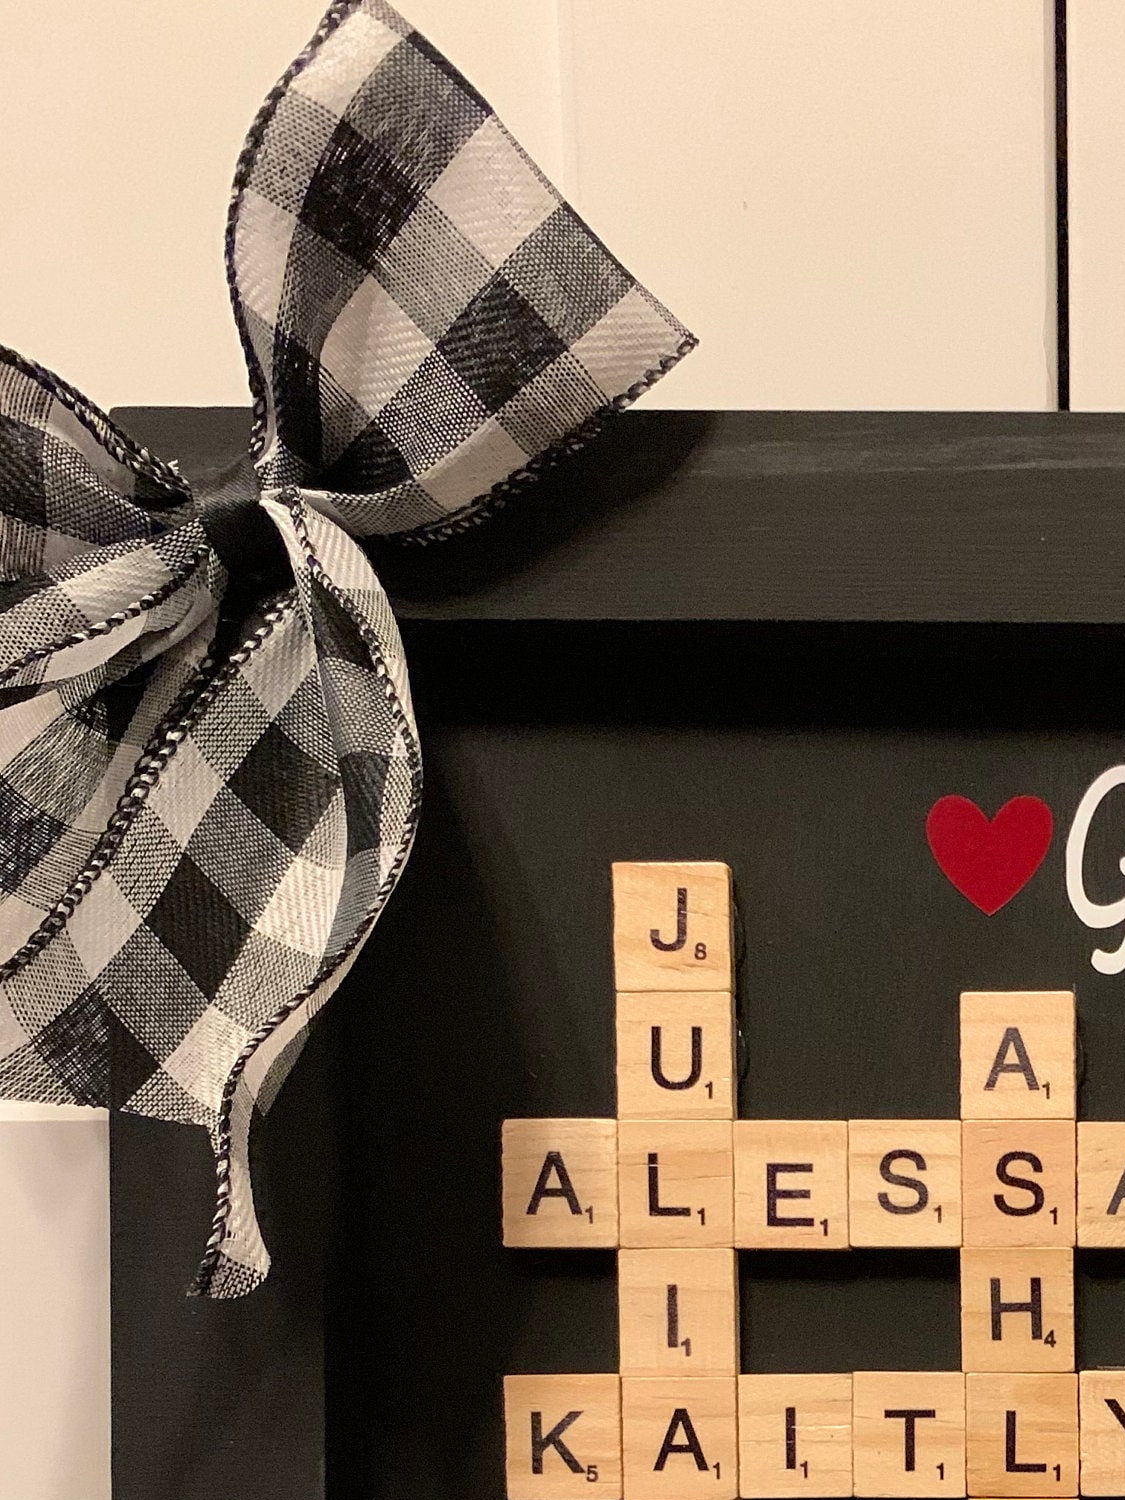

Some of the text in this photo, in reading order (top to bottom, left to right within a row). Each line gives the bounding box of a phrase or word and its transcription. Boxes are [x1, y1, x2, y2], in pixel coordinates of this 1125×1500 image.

[693, 942, 708, 961] 8
[703, 1081, 714, 1100] 1
[1040, 1082, 1051, 1100] 1
[583, 1206, 595, 1224] 1
[695, 1207, 707, 1226] 1
[933, 1205, 943, 1223] 1
[1048, 1206, 1059, 1225] 1
[818, 1218, 829, 1237] 1
[679, 1338, 692, 1357] 1
[1042, 1329, 1058, 1348] 4
[585, 1464, 600, 1483] 5
[711, 1461, 722, 1480] 1
[798, 1460, 809, 1479] 1
[935, 1462, 946, 1481] 1
[1051, 1463, 1062, 1482] 1
